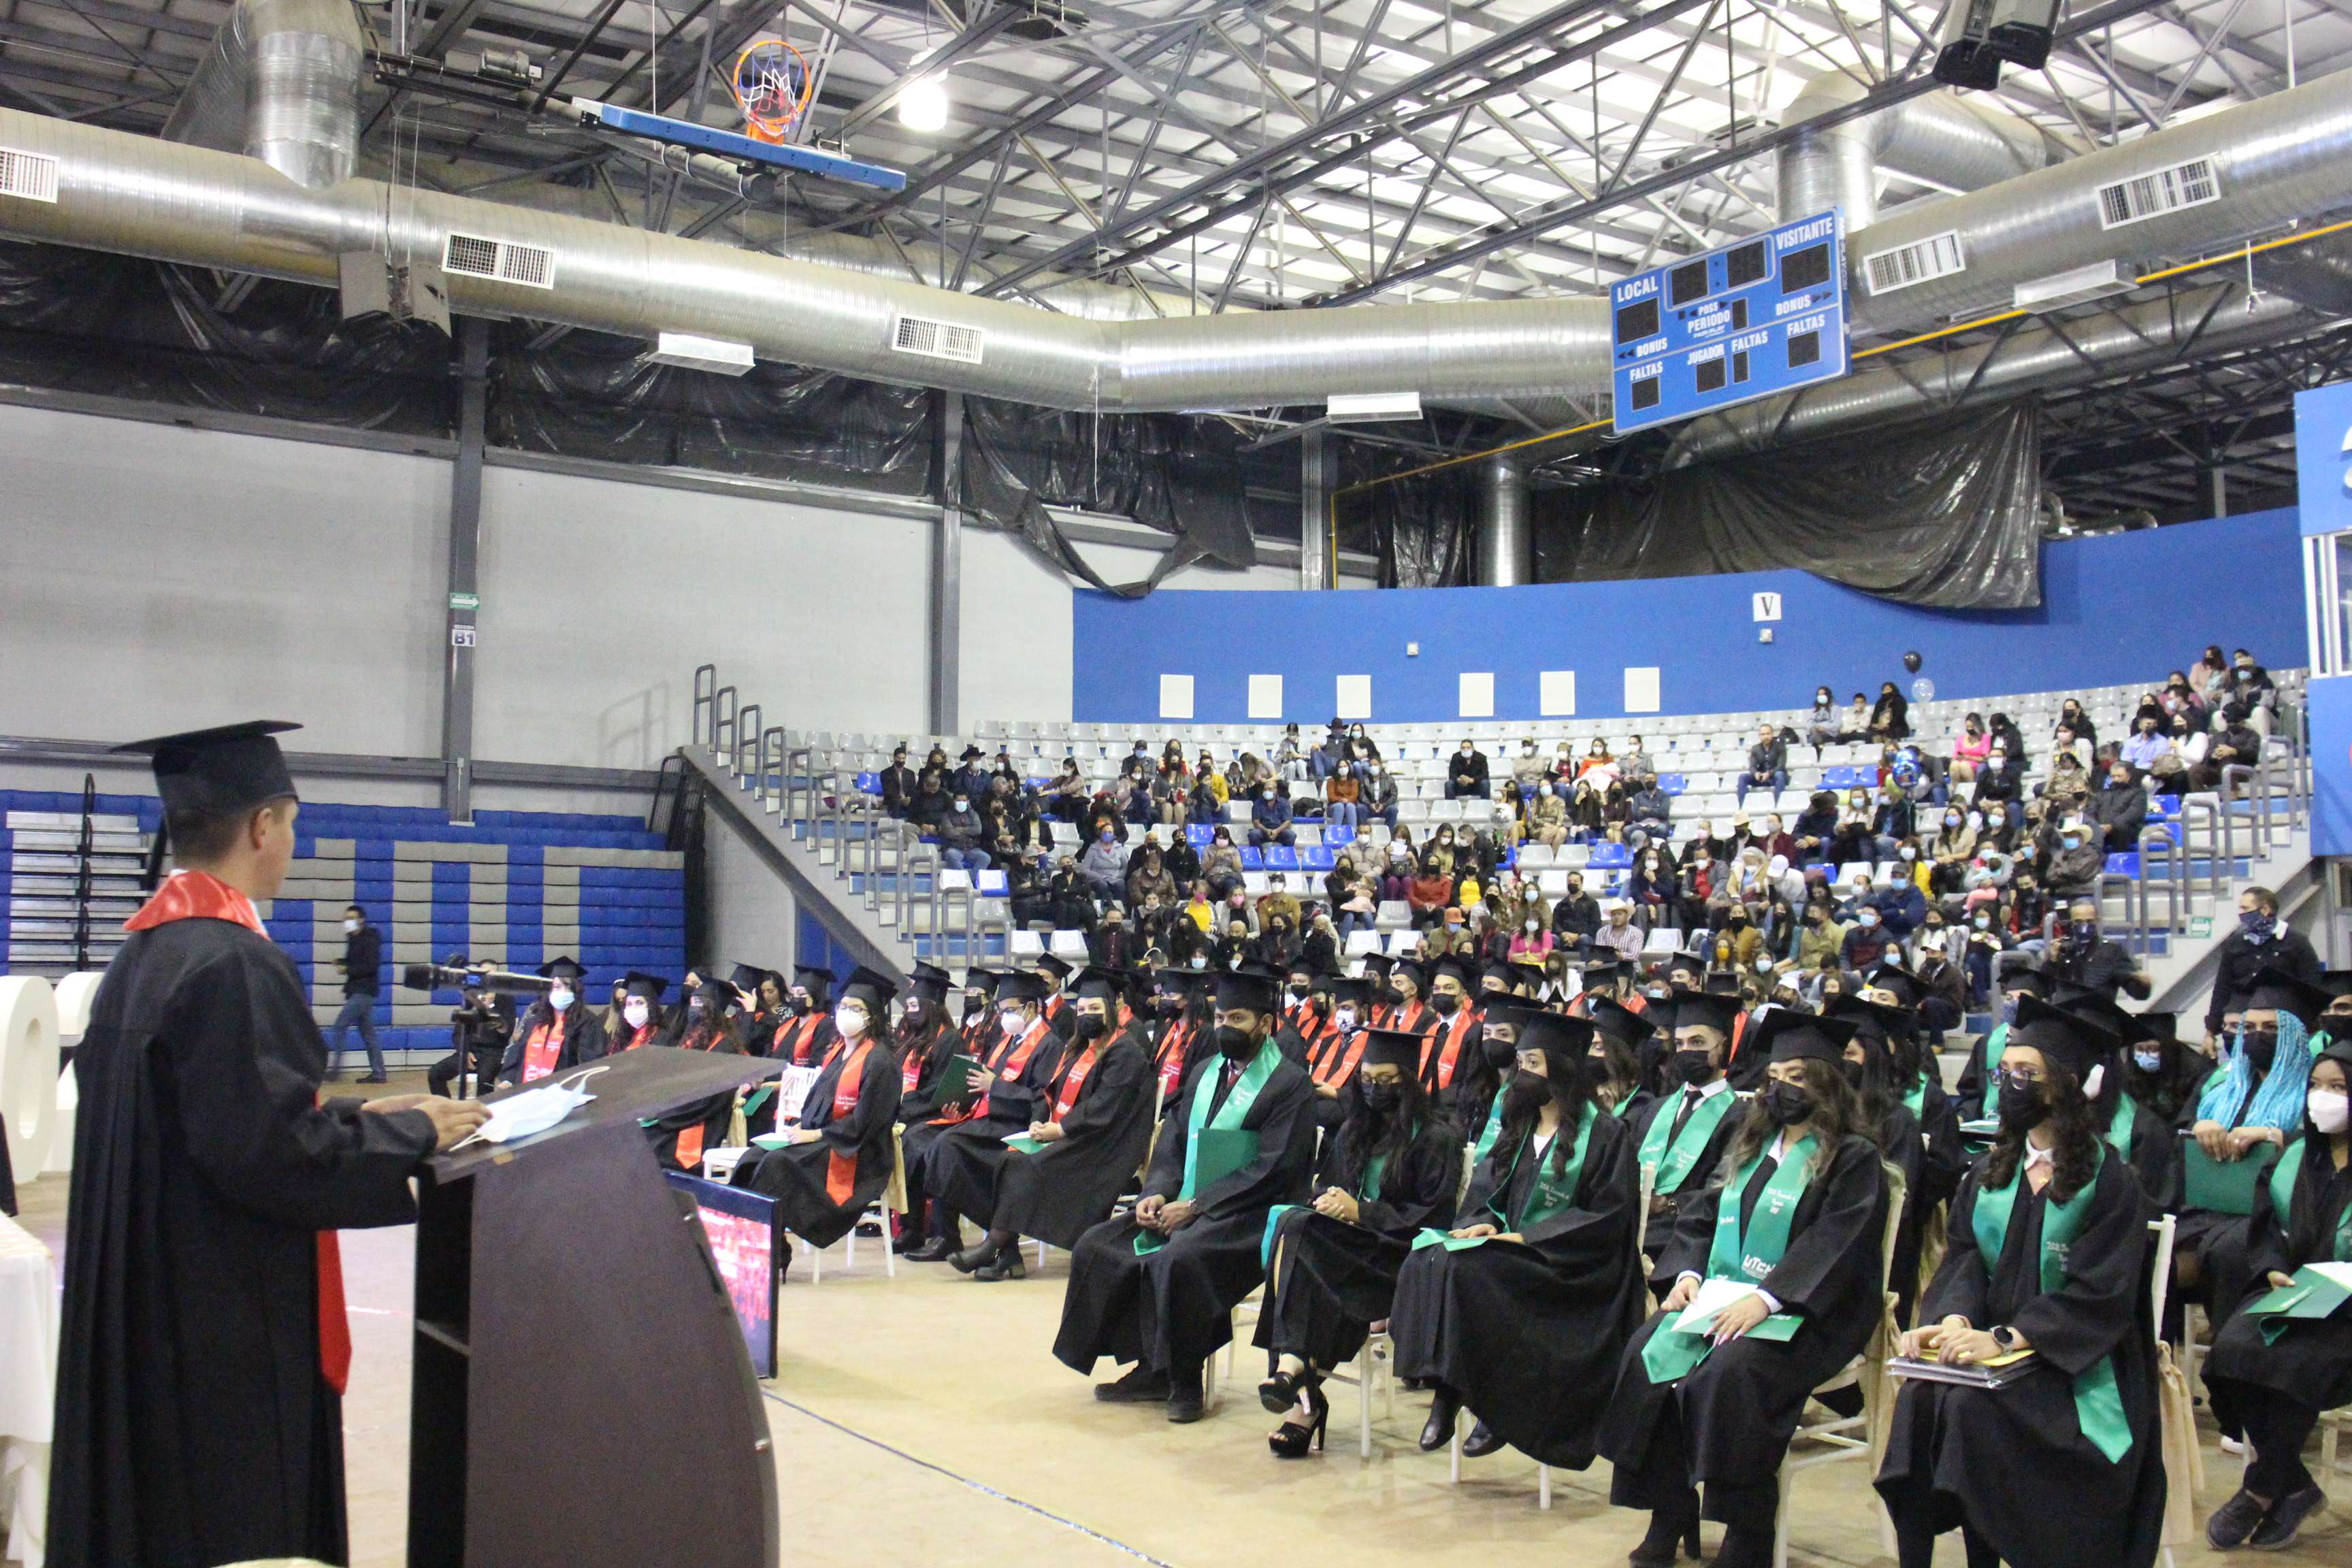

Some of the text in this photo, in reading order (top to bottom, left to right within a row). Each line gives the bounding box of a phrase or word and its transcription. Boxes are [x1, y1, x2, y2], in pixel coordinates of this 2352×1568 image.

[1776, 217, 1833, 250] VISITANTE
[1617, 276, 1659, 303] LOCAL
[1698, 301, 1719, 316] POSS
[1776, 295, 1811, 316] BONUS
[1688, 309, 1731, 333] PERIODO
[1786, 314, 1825, 336] FALTAS
[1637, 338, 1668, 357] BONUS
[1731, 331, 1768, 352] FALTAS
[1687, 343, 1725, 365] JUGADOR
[1630, 361, 1664, 381] FALTAS
[1761, 595, 1774, 617] V
[455, 632, 474, 645] B1
